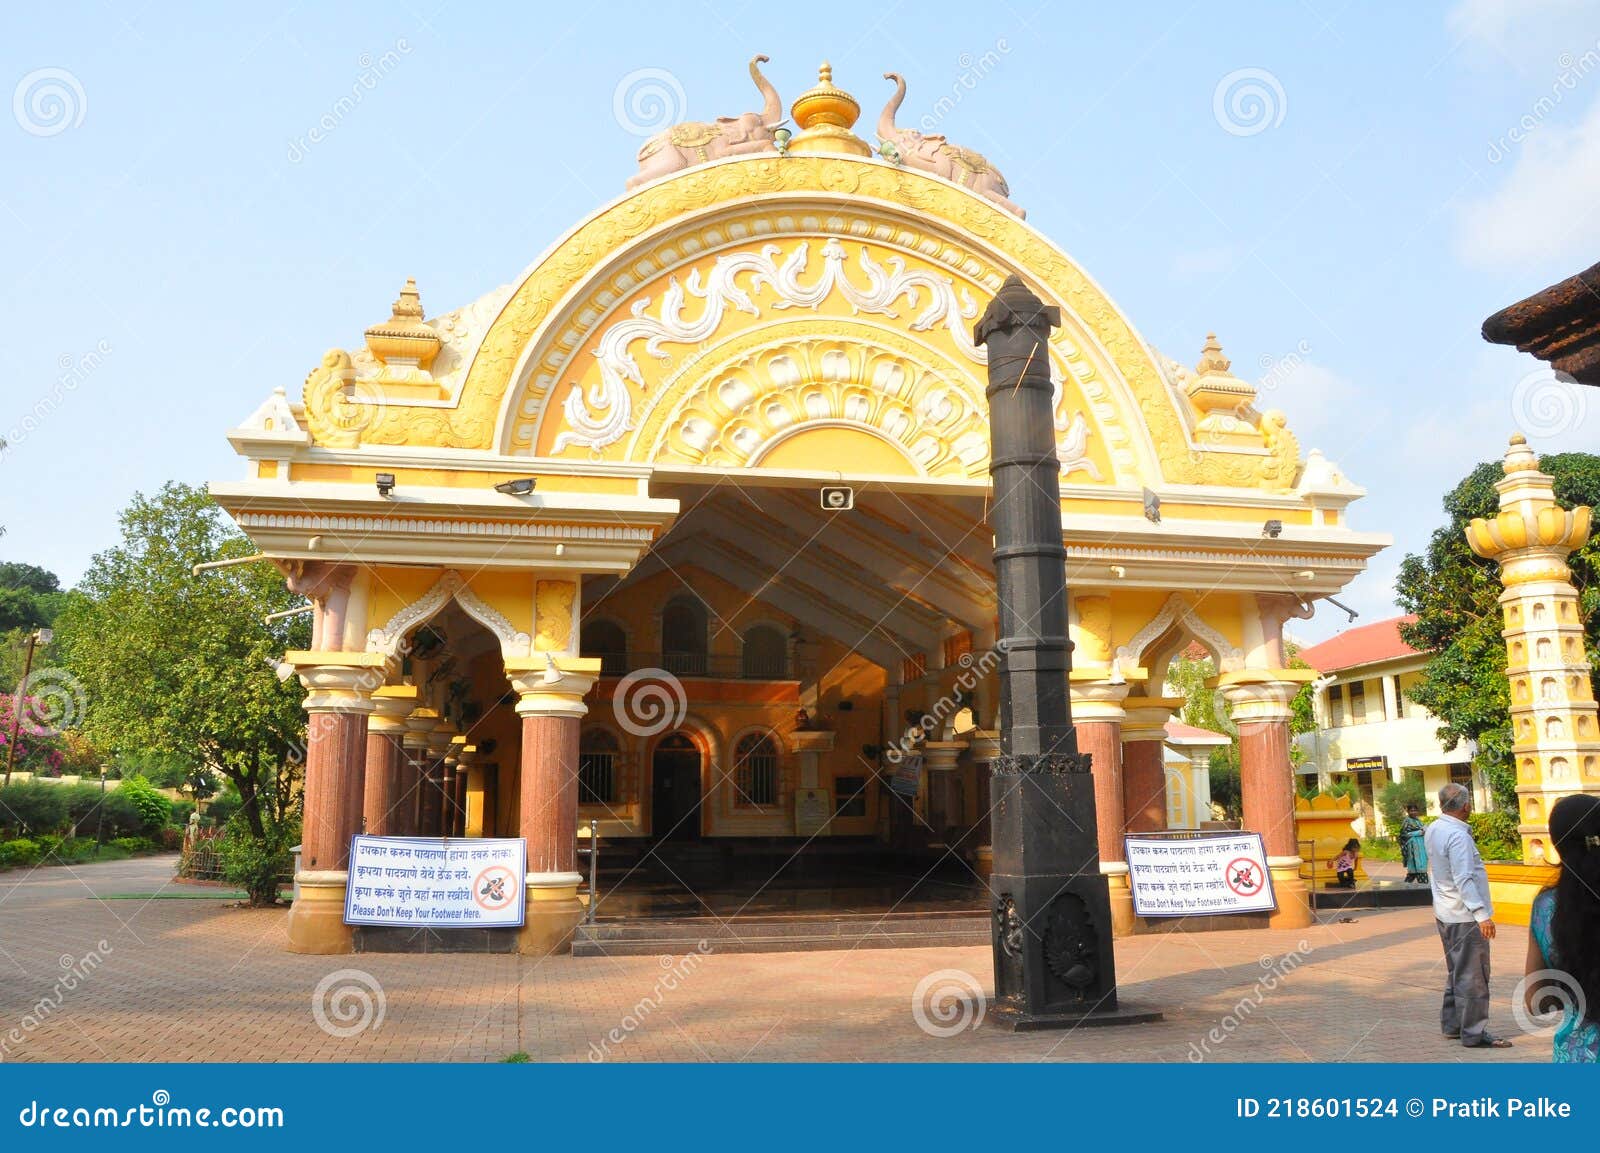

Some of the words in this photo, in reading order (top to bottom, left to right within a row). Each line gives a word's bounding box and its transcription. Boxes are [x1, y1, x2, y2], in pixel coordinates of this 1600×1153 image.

[1139, 898, 1156, 909] Please
[1184, 898, 1196, 908] Your
[352, 903, 375, 916] Please
[377, 905, 394, 918] Don't
[396, 906, 413, 920] Keep
[415, 907, 430, 918] Your
[431, 907, 463, 919] Footwear
[463, 907, 481, 919] Here.
